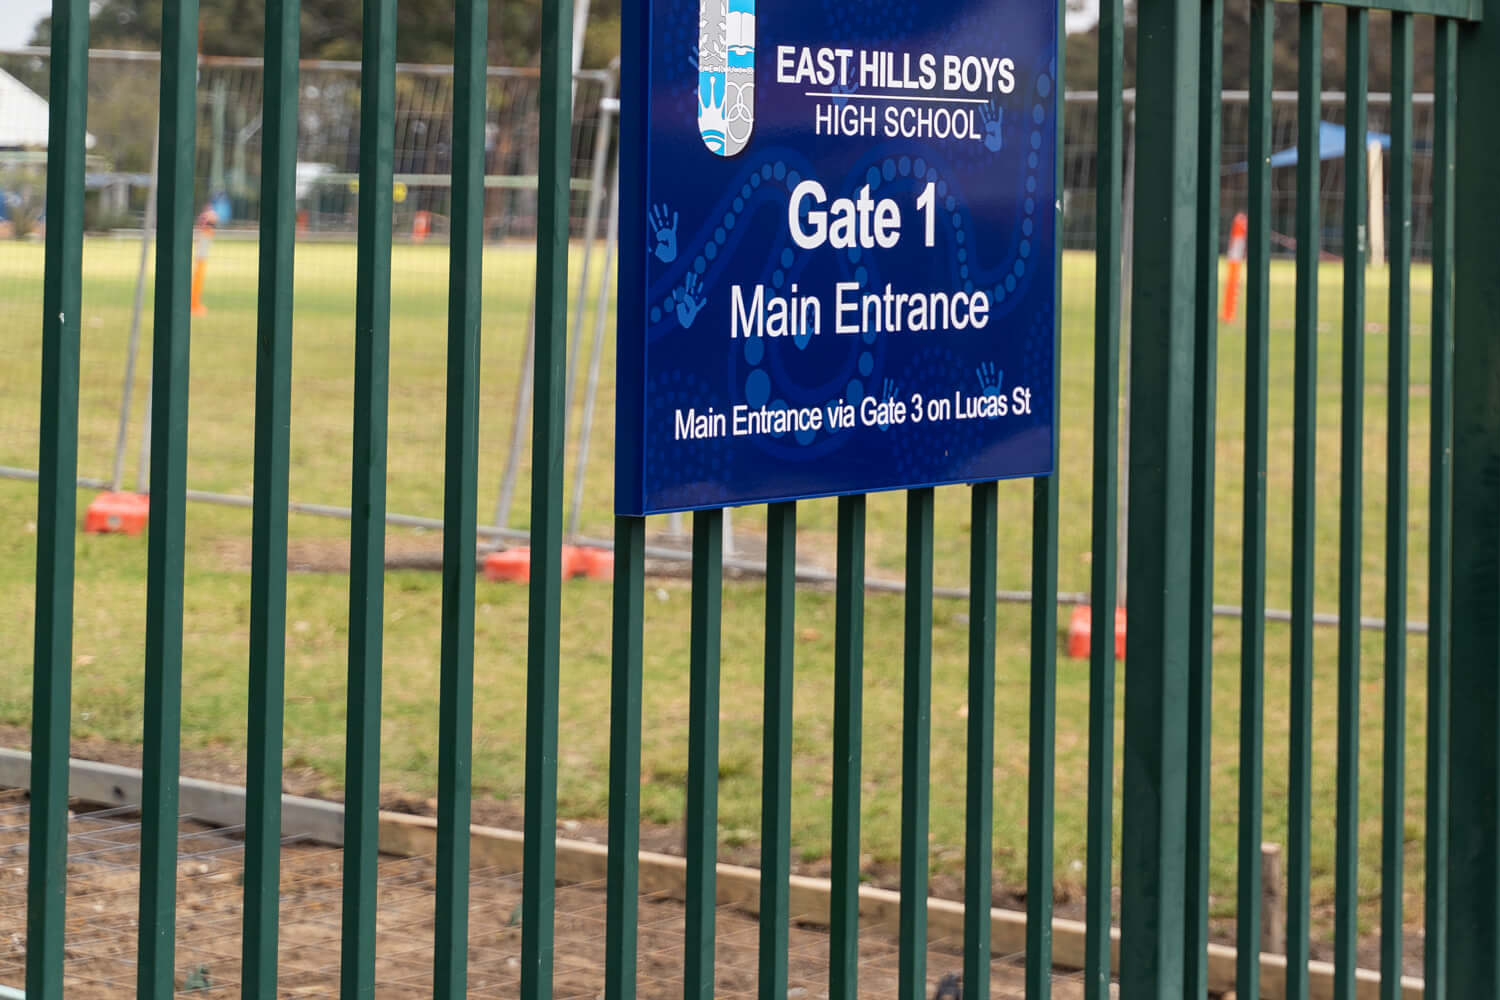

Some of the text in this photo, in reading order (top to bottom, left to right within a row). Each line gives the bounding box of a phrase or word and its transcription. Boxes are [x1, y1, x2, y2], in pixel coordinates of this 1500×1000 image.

[776, 45, 1015, 94] EAST HILLS BOYS
[815, 103, 981, 140] HIGH SCHOOL
[788, 179, 936, 250] Gate 1
[730, 281, 990, 339] Main Entrance
[675, 386, 1032, 441] Main Entrance via Gate 3 on Lucas St
